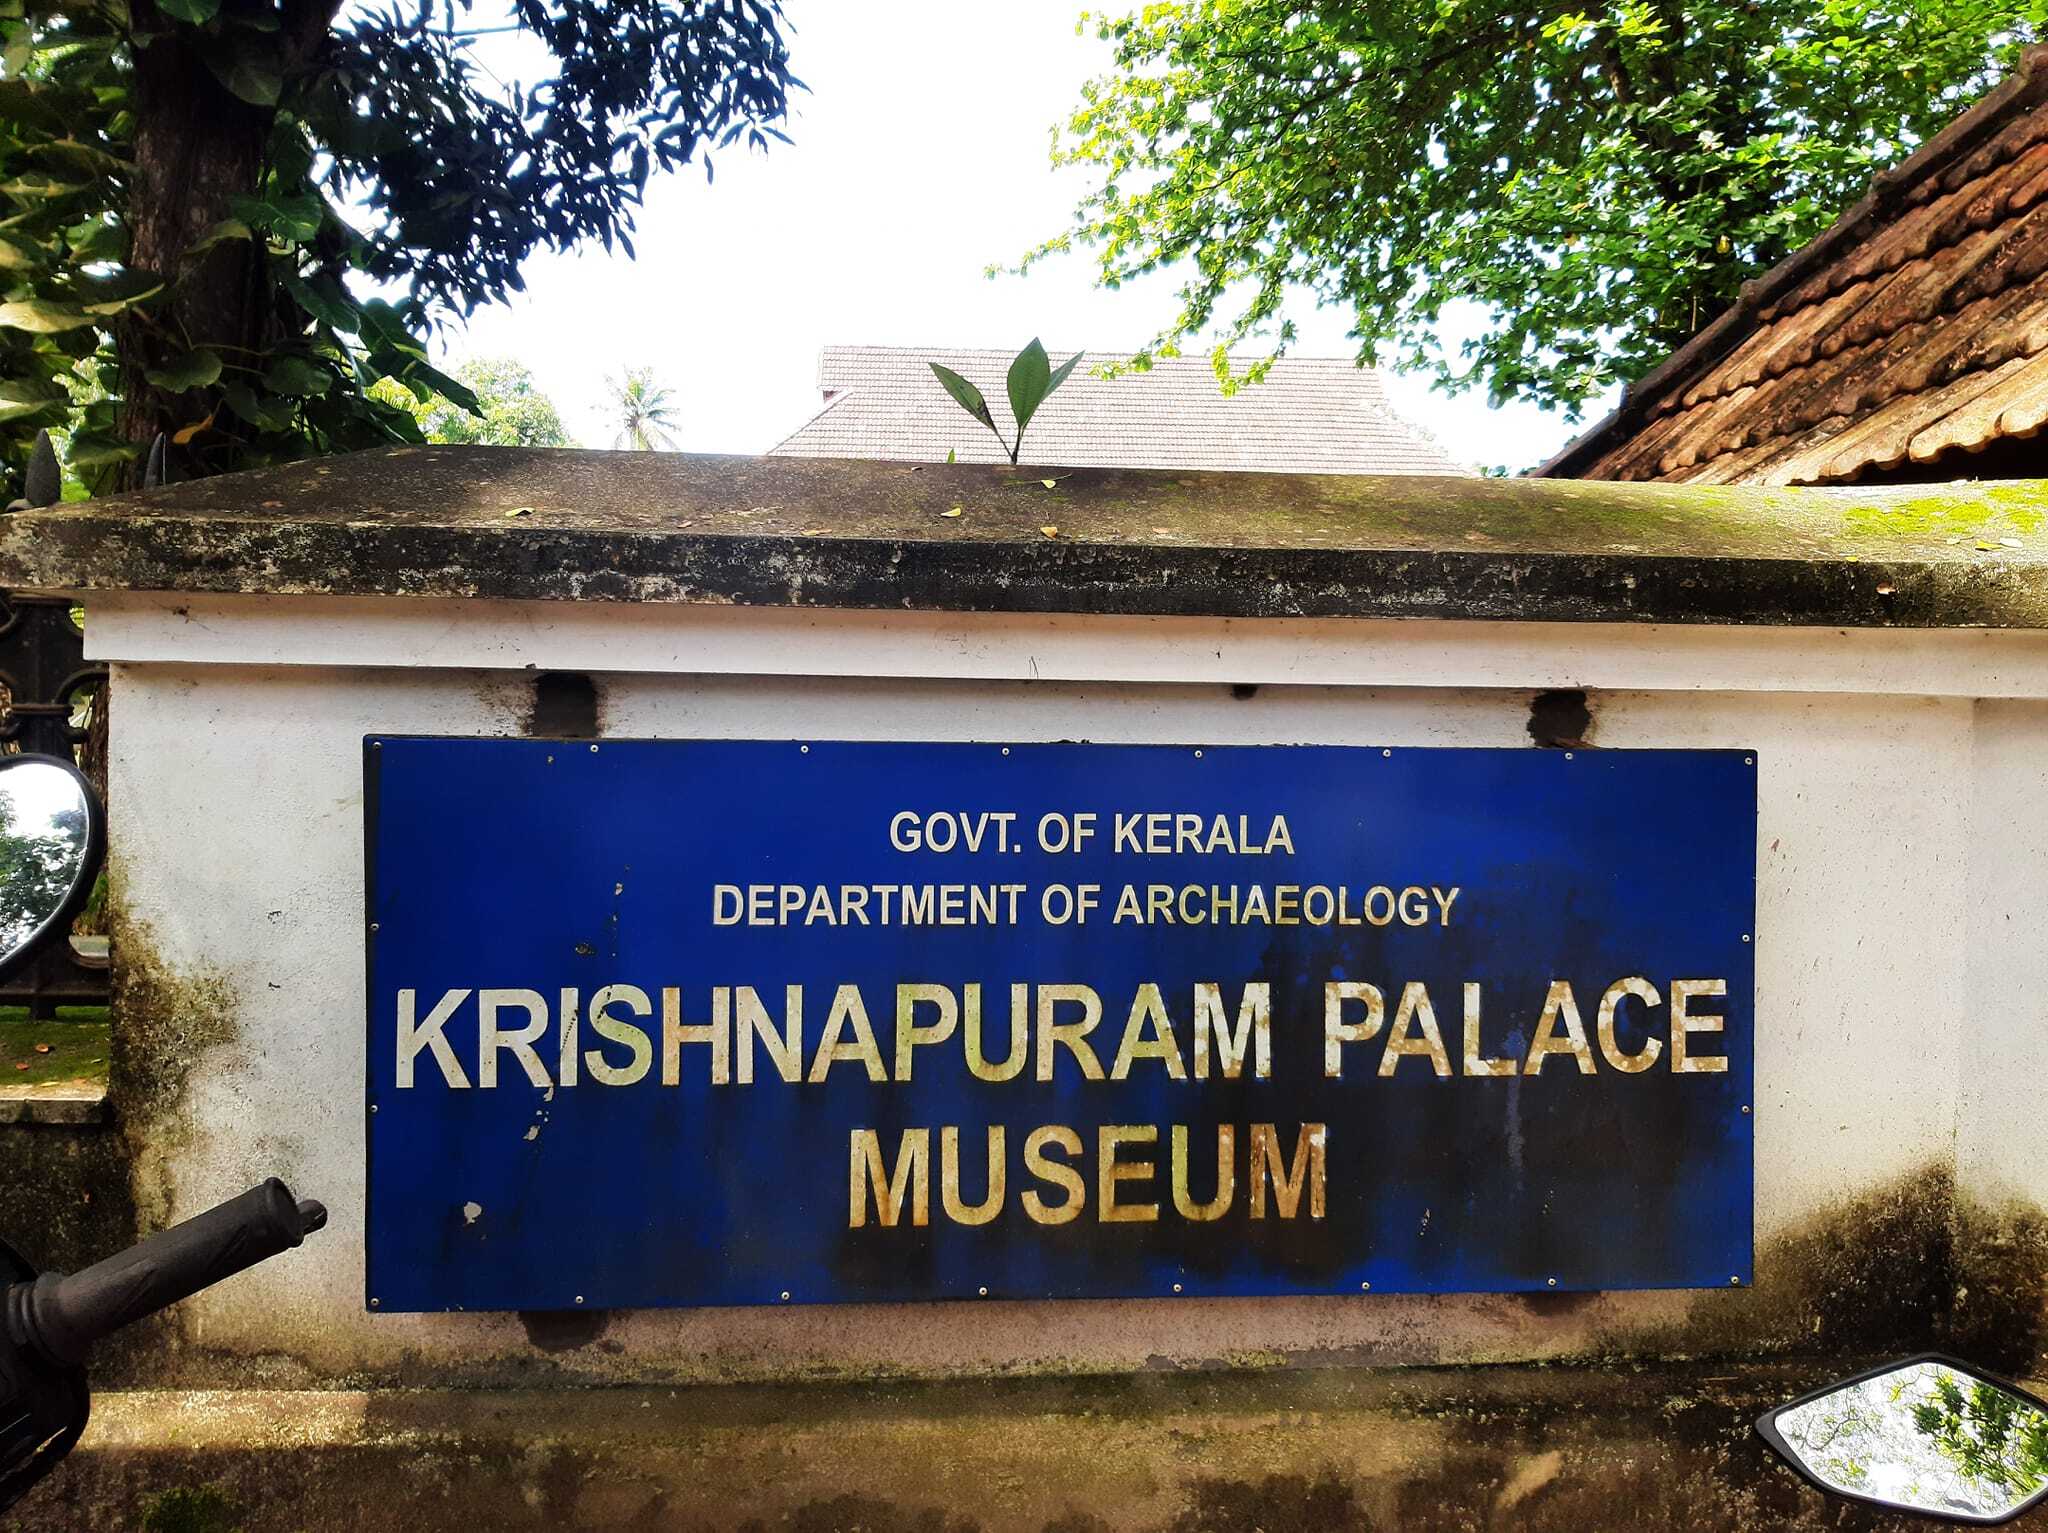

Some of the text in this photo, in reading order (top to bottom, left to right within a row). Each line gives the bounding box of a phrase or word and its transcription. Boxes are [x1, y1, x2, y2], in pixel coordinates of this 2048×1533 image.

[889, 811, 1295, 855] GOVT. OF KERALA
[713, 884, 1460, 927] DEPARTMENT OF ARCHAEOLOGY
[395, 976, 1729, 1089] KRISHNAPURAM PALACE
[849, 1122, 1328, 1229] MUSEUM
